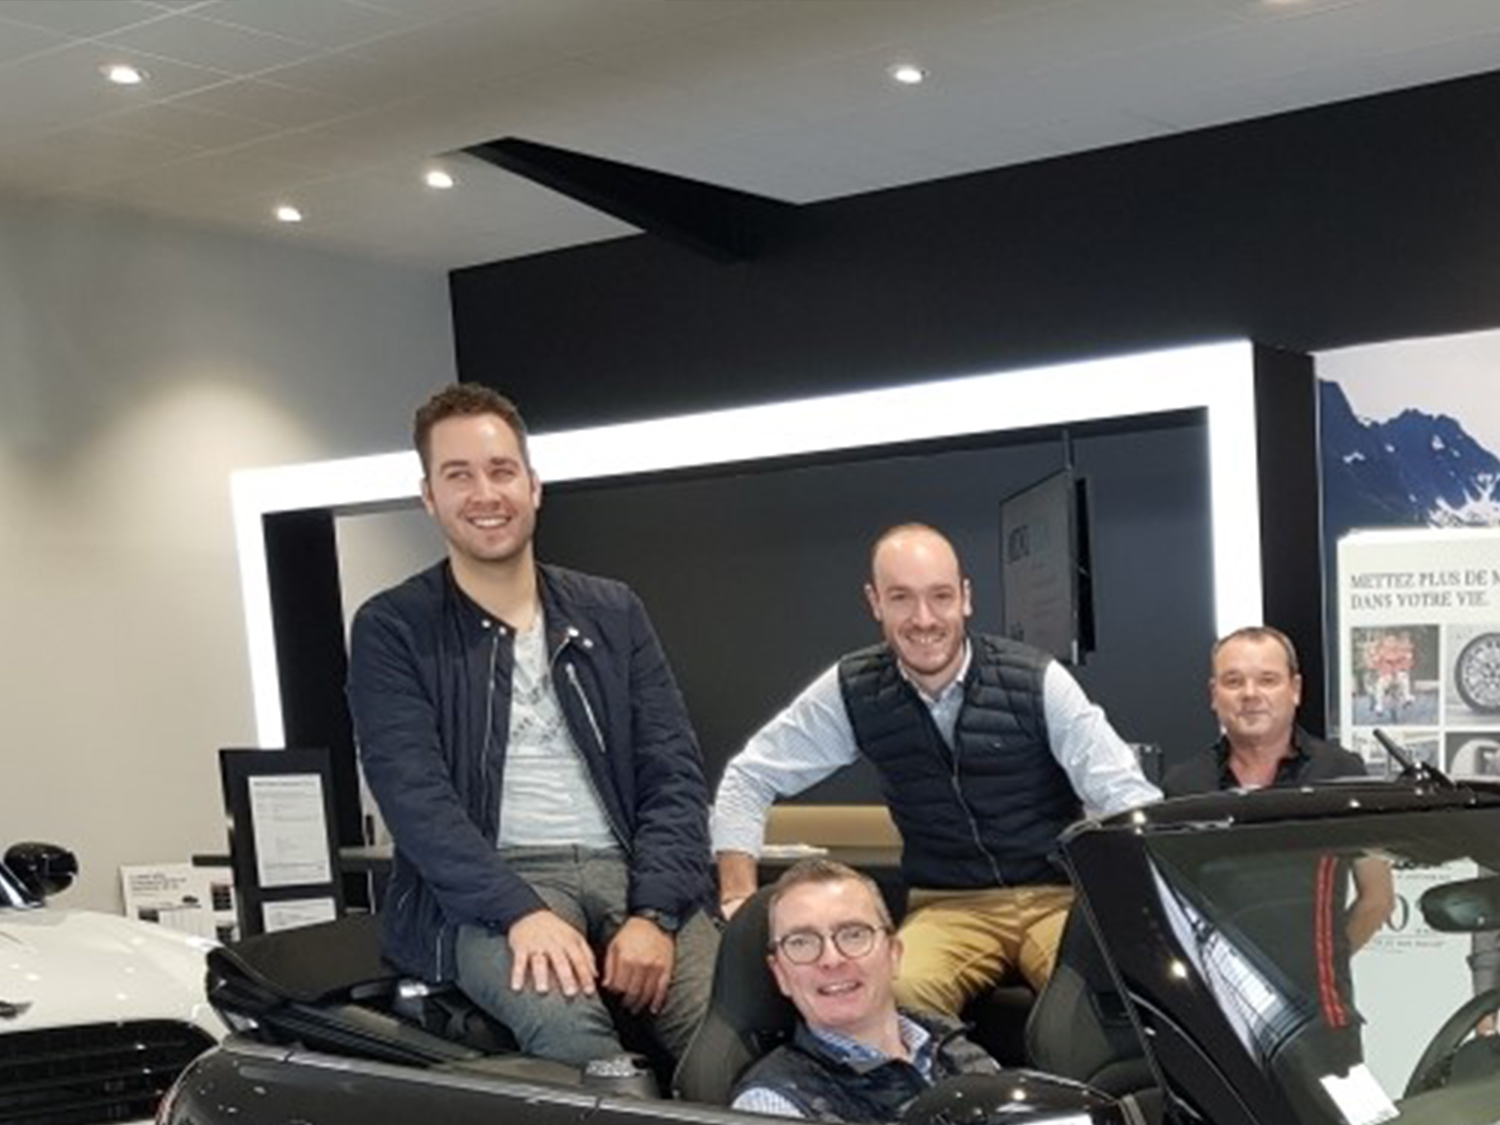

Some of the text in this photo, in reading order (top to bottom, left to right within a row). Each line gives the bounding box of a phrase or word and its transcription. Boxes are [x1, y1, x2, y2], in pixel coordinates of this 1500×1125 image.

[1350, 571, 1415, 589] METTEZ
[1418, 569, 1461, 587] PLUS
[1465, 568, 1488, 586] DE
[1350, 592, 1392, 611] DANS
[1396, 591, 1452, 608] VOTRE
